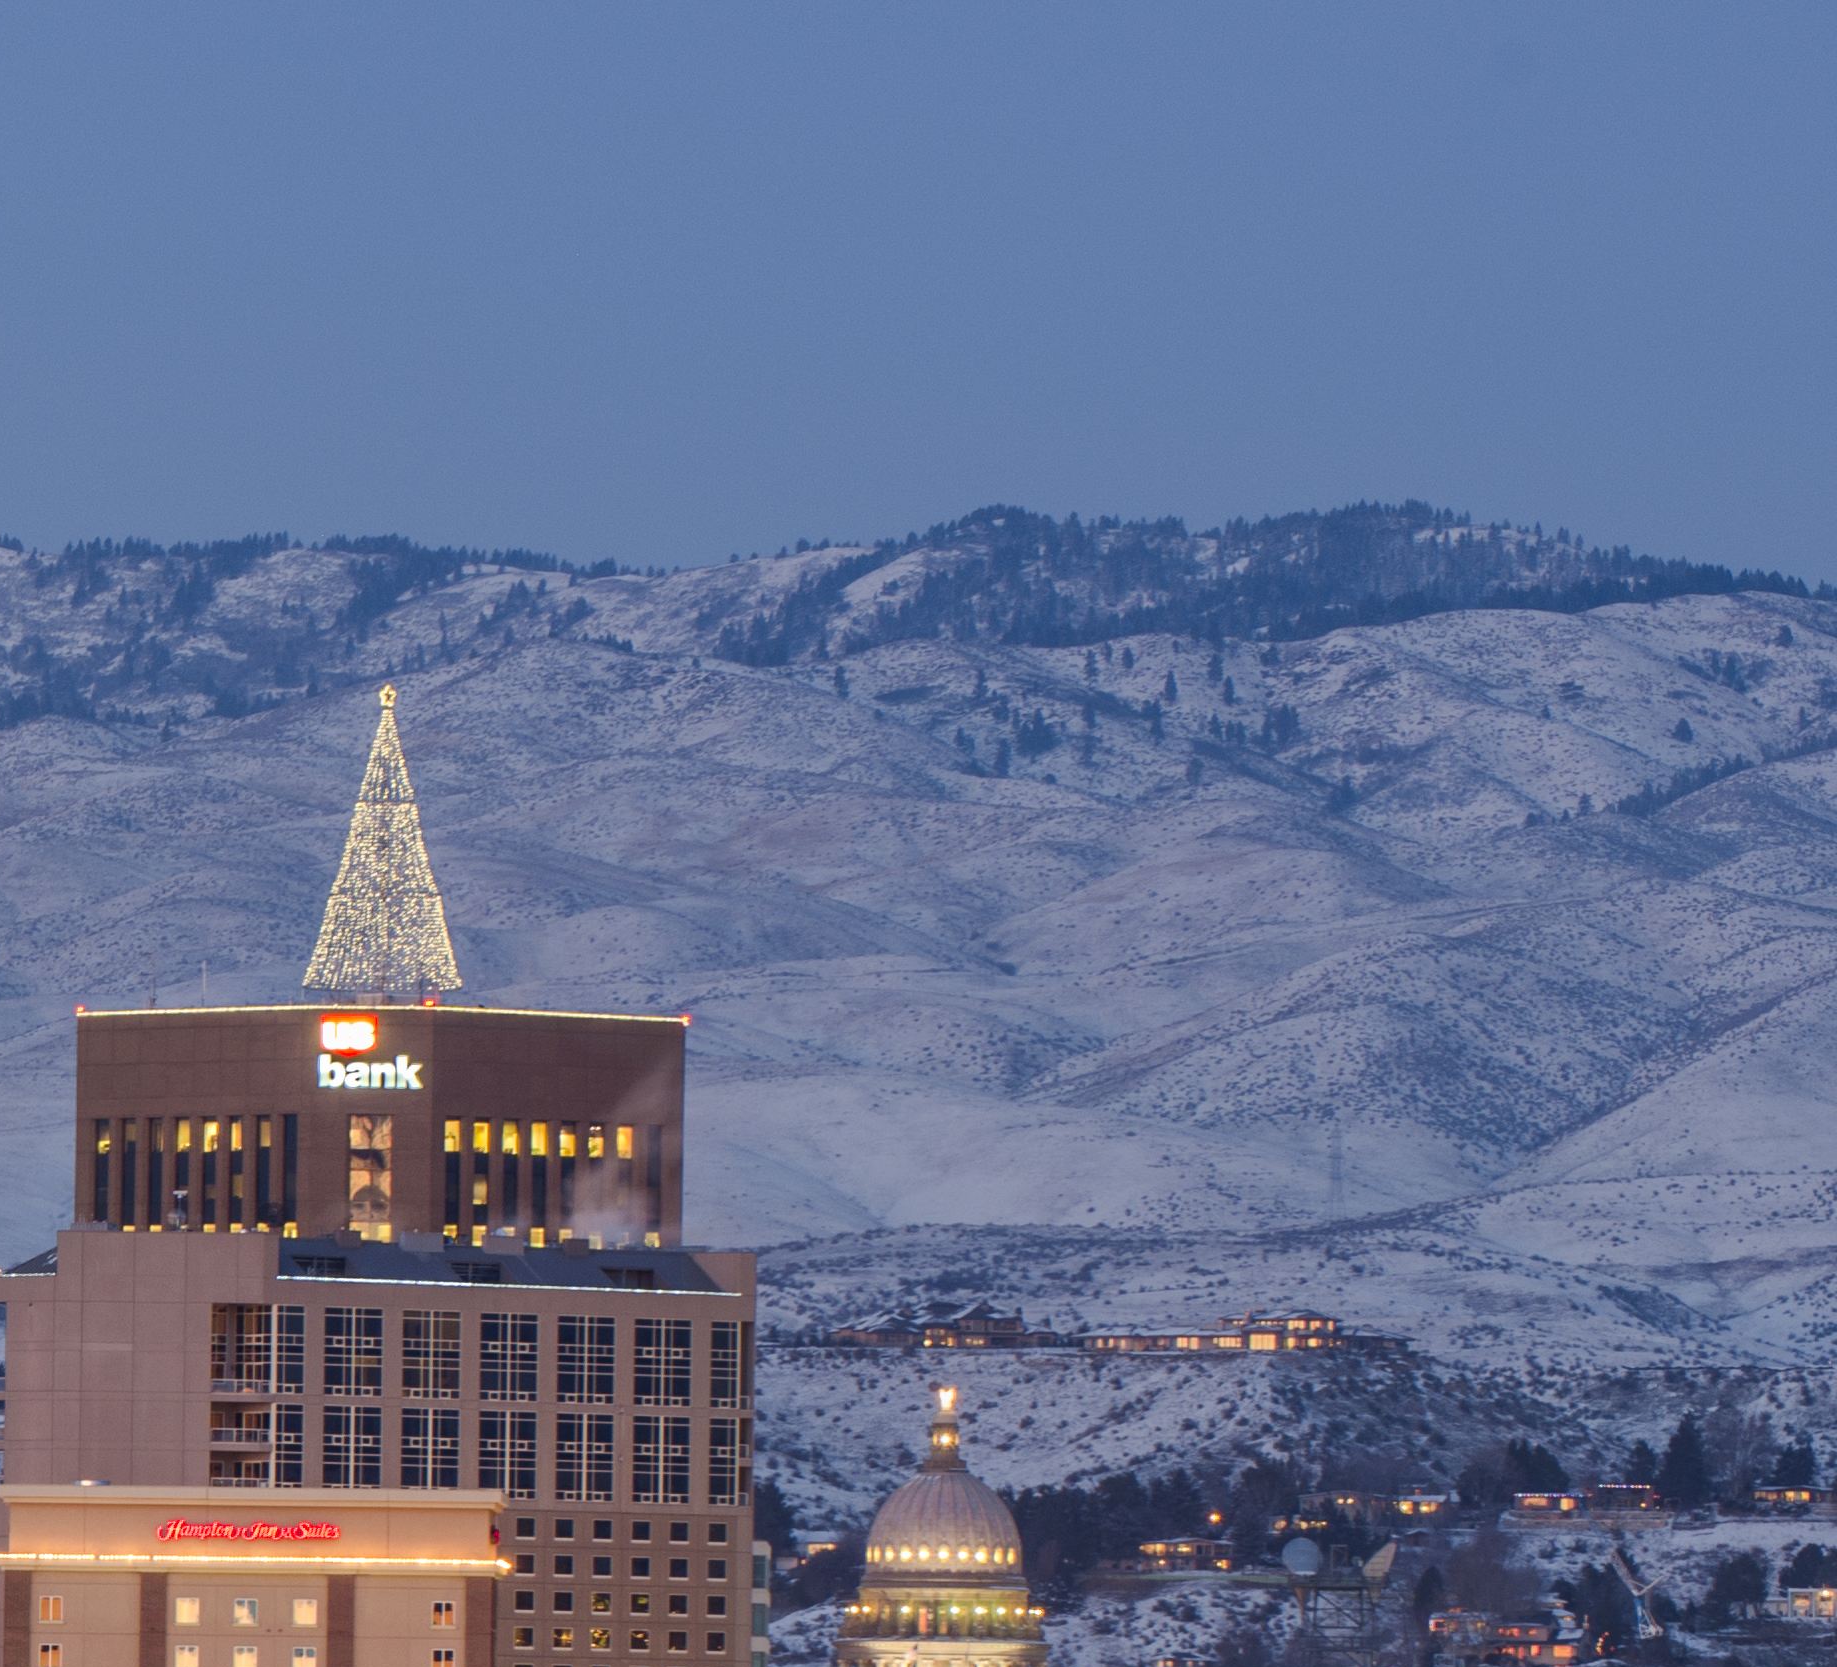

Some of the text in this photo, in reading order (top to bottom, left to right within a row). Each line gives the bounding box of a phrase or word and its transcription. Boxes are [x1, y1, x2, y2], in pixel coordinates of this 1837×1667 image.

[317, 1053, 424, 1090] bank
[157, 1519, 242, 1541] Hampton
[241, 1521, 282, 1541] Inn
[293, 1521, 341, 1541] Suites
